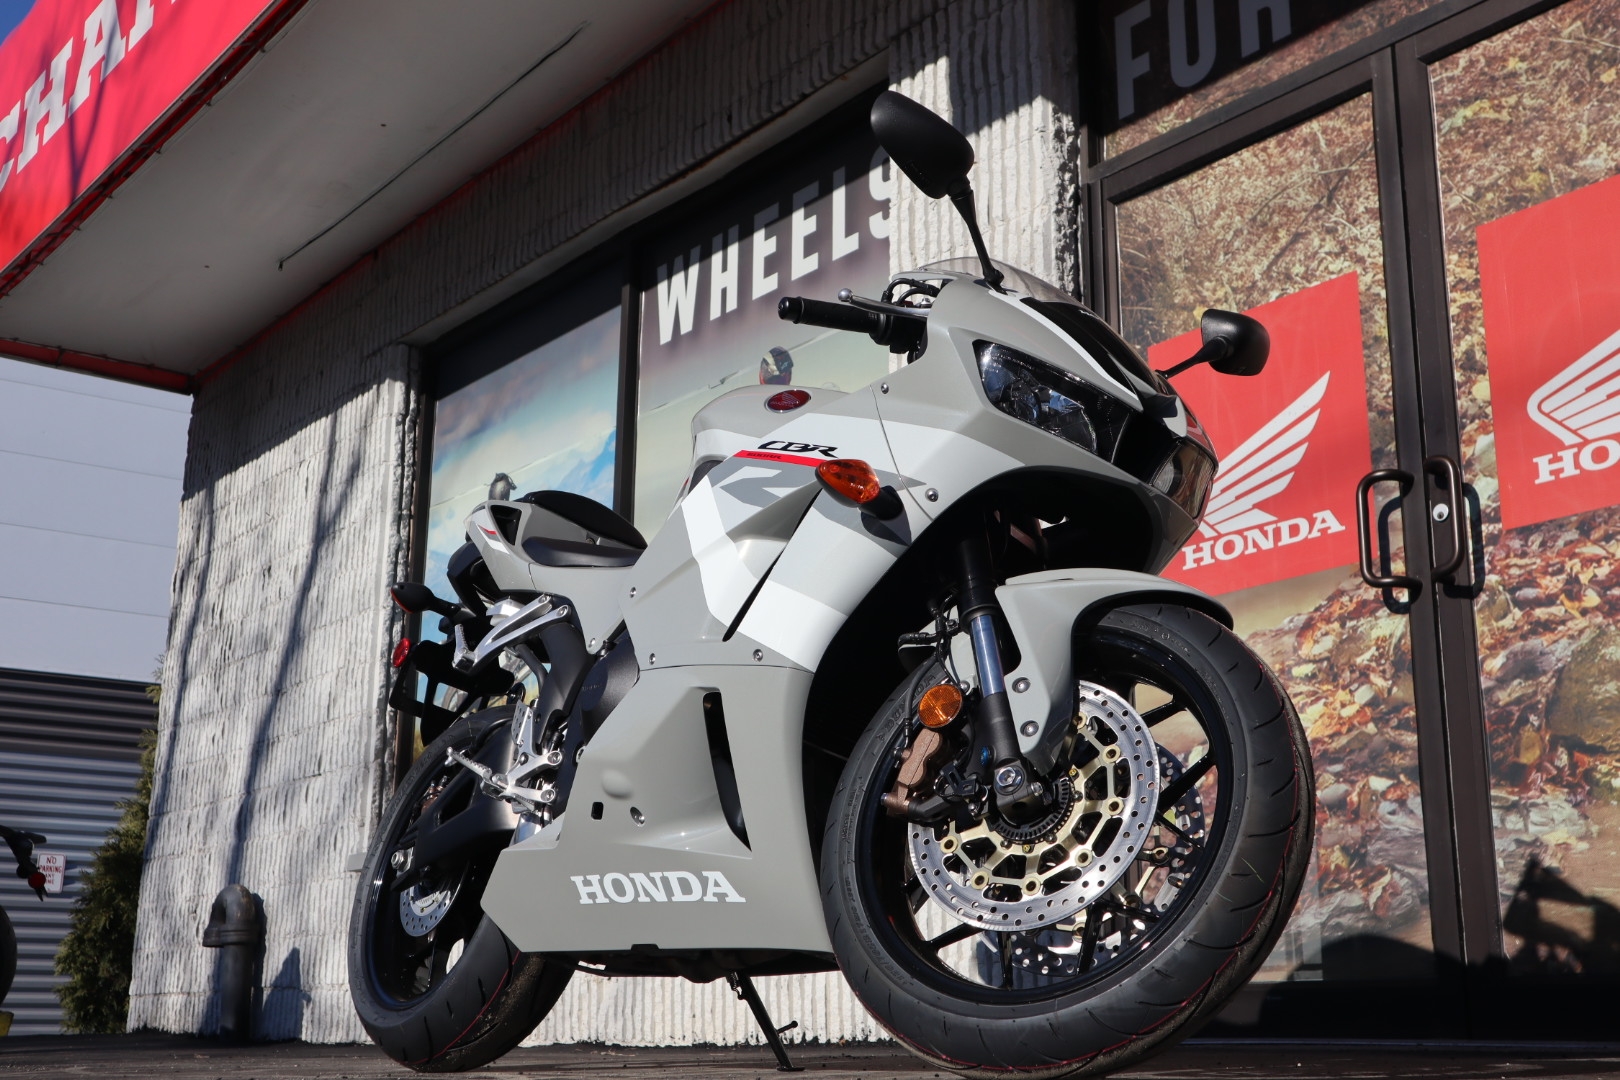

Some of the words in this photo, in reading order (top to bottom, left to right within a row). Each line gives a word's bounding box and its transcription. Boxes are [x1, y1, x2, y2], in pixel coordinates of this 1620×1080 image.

[757, 440, 839, 459] CBR
[1181, 509, 1346, 571] HONDA
[40, 865, 62, 874] PARKING
[46, 856, 57, 865] NO
[570, 871, 747, 904] HONDA
